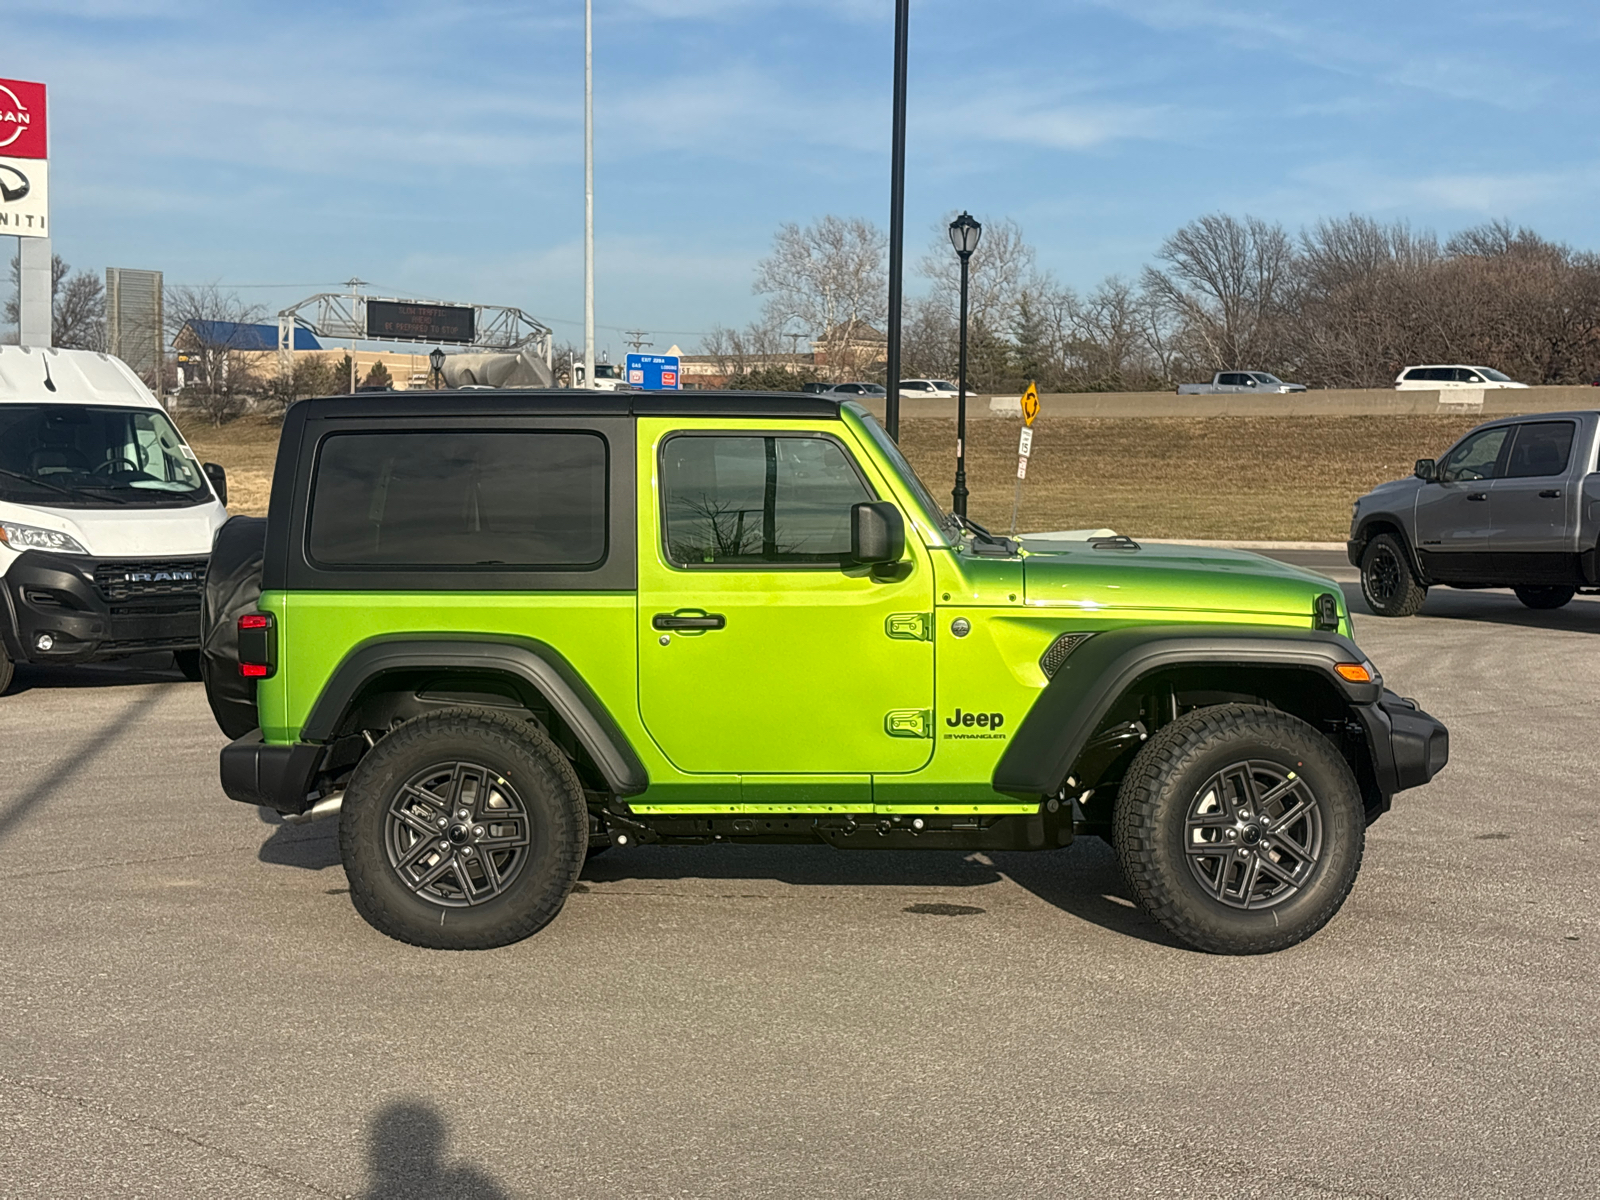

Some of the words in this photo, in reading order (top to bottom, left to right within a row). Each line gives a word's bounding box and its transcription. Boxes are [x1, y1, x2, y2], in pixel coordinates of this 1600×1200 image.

[398, 307, 416, 315] SLOW
[418, 308, 446, 317] TRAFFIC
[411, 316, 432, 325] AHEAD
[384, 322, 394, 331] BE
[396, 323, 428, 333] PREPARED
[430, 325, 440, 333] TO
[441, 326, 459, 334] STOP
[131, 572, 193, 582] RAM
[945, 708, 1004, 731] Jeep
